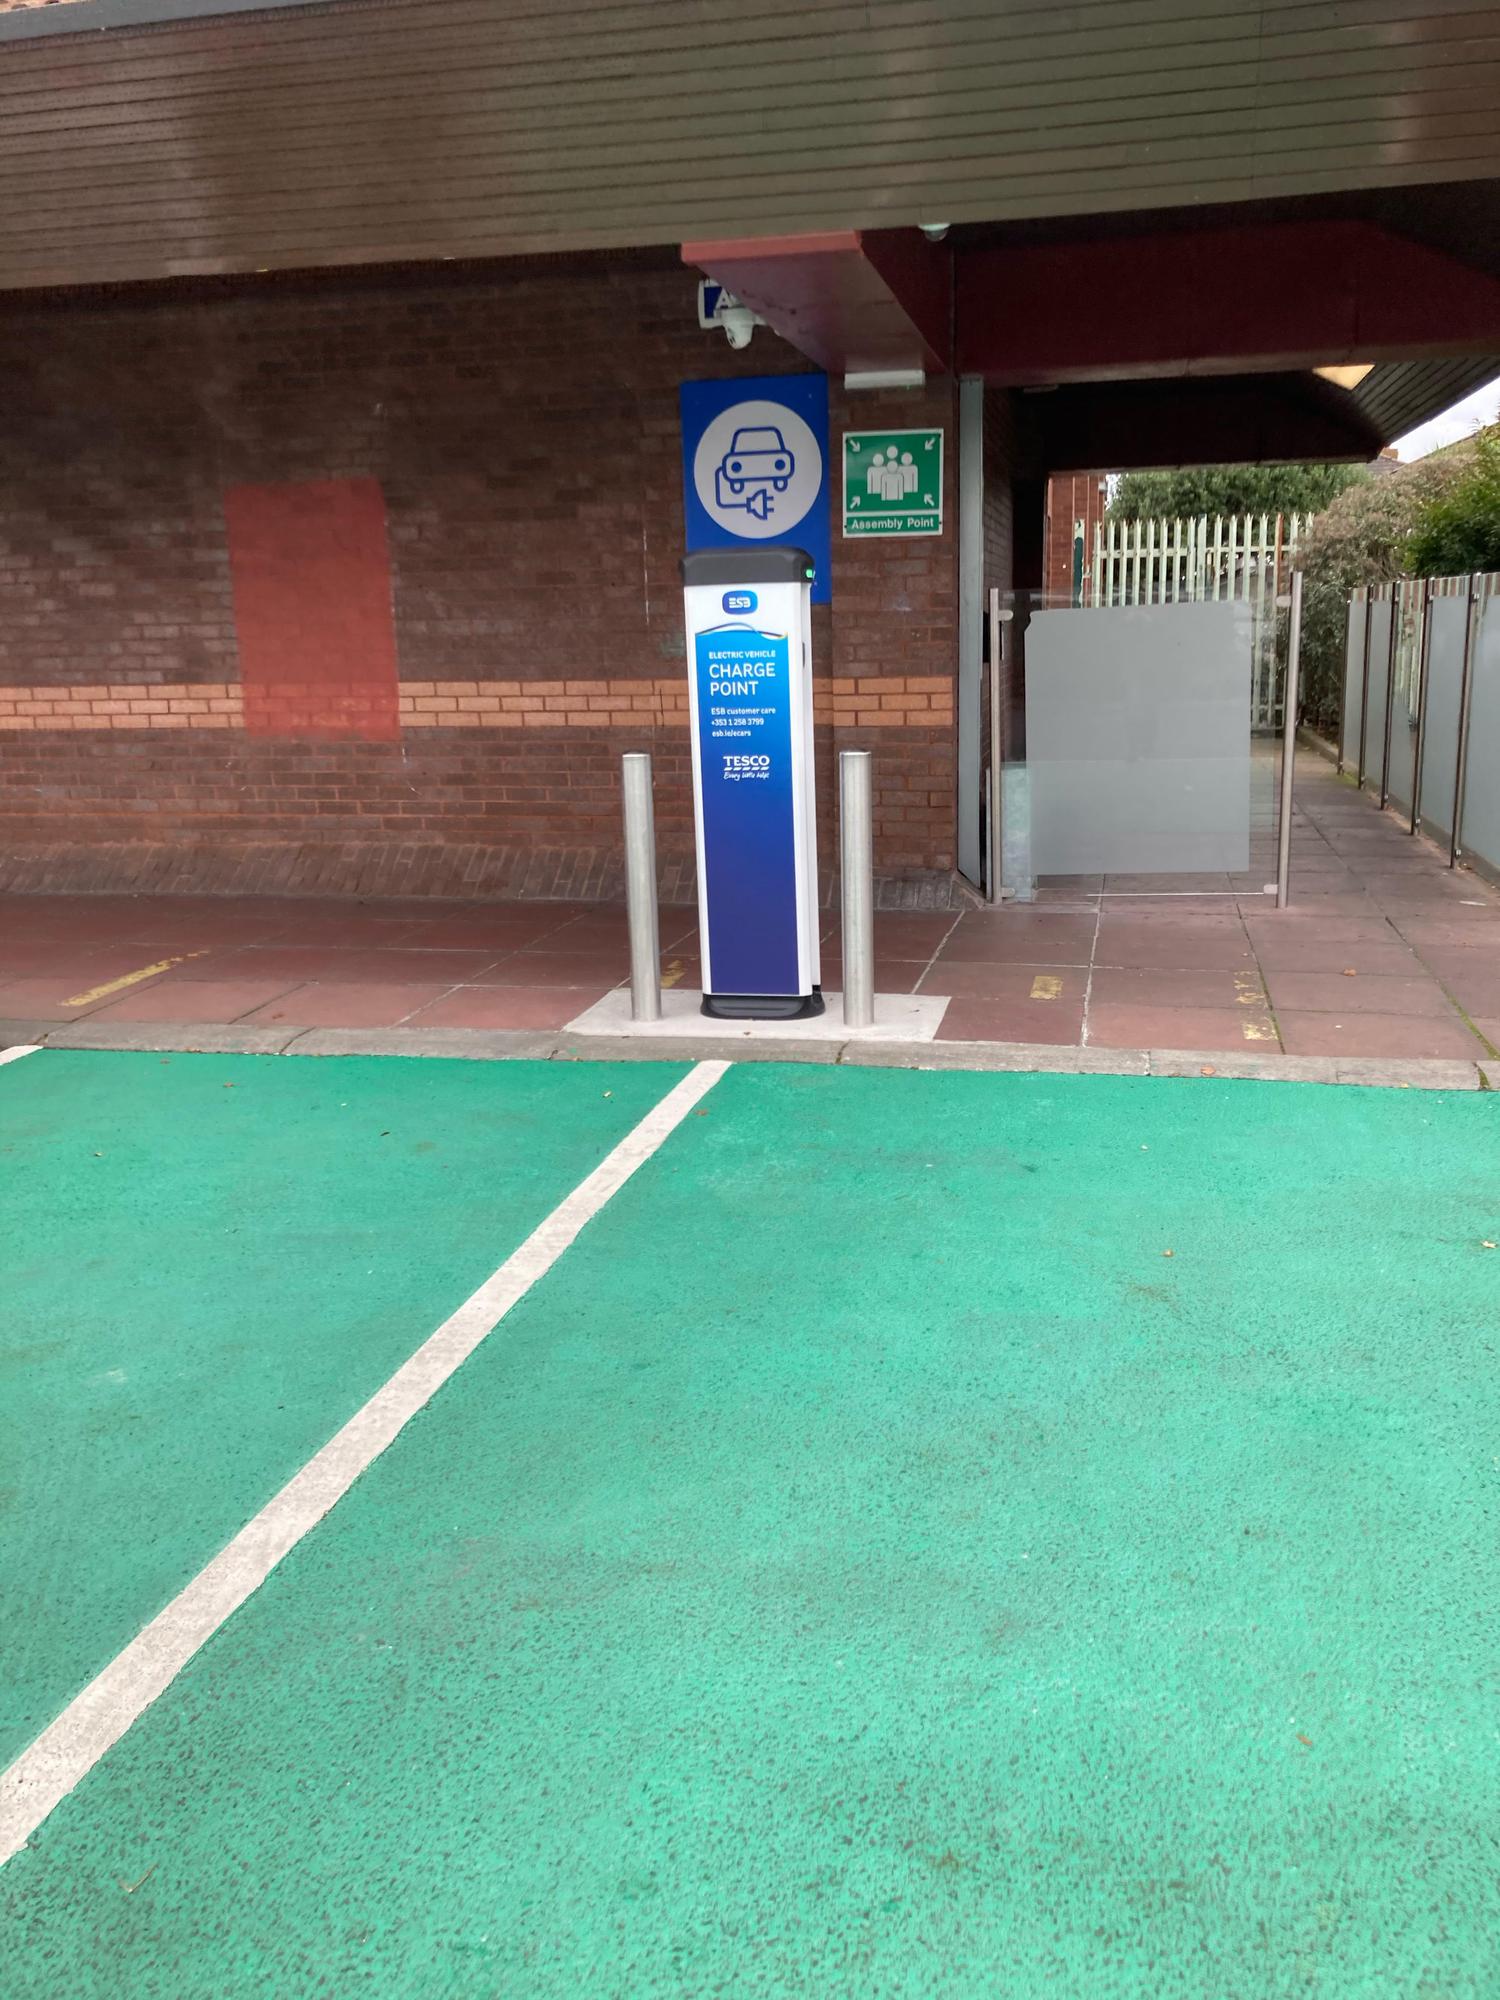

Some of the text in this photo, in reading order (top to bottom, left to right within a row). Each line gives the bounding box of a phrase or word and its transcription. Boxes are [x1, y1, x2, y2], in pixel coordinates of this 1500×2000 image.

[851, 517, 934, 530] Assembly Point
[728, 597, 751, 609] ESB
[708, 650, 776, 659] ELECTRIC VEHICLE
[709, 662, 776, 678] CHARGE
[710, 680, 758, 696] POINT
[711, 707, 726, 715] ESB
[727, 707, 760, 715] customer
[723, 755, 770, 767] TESCO
[723, 772, 741, 781] Every
